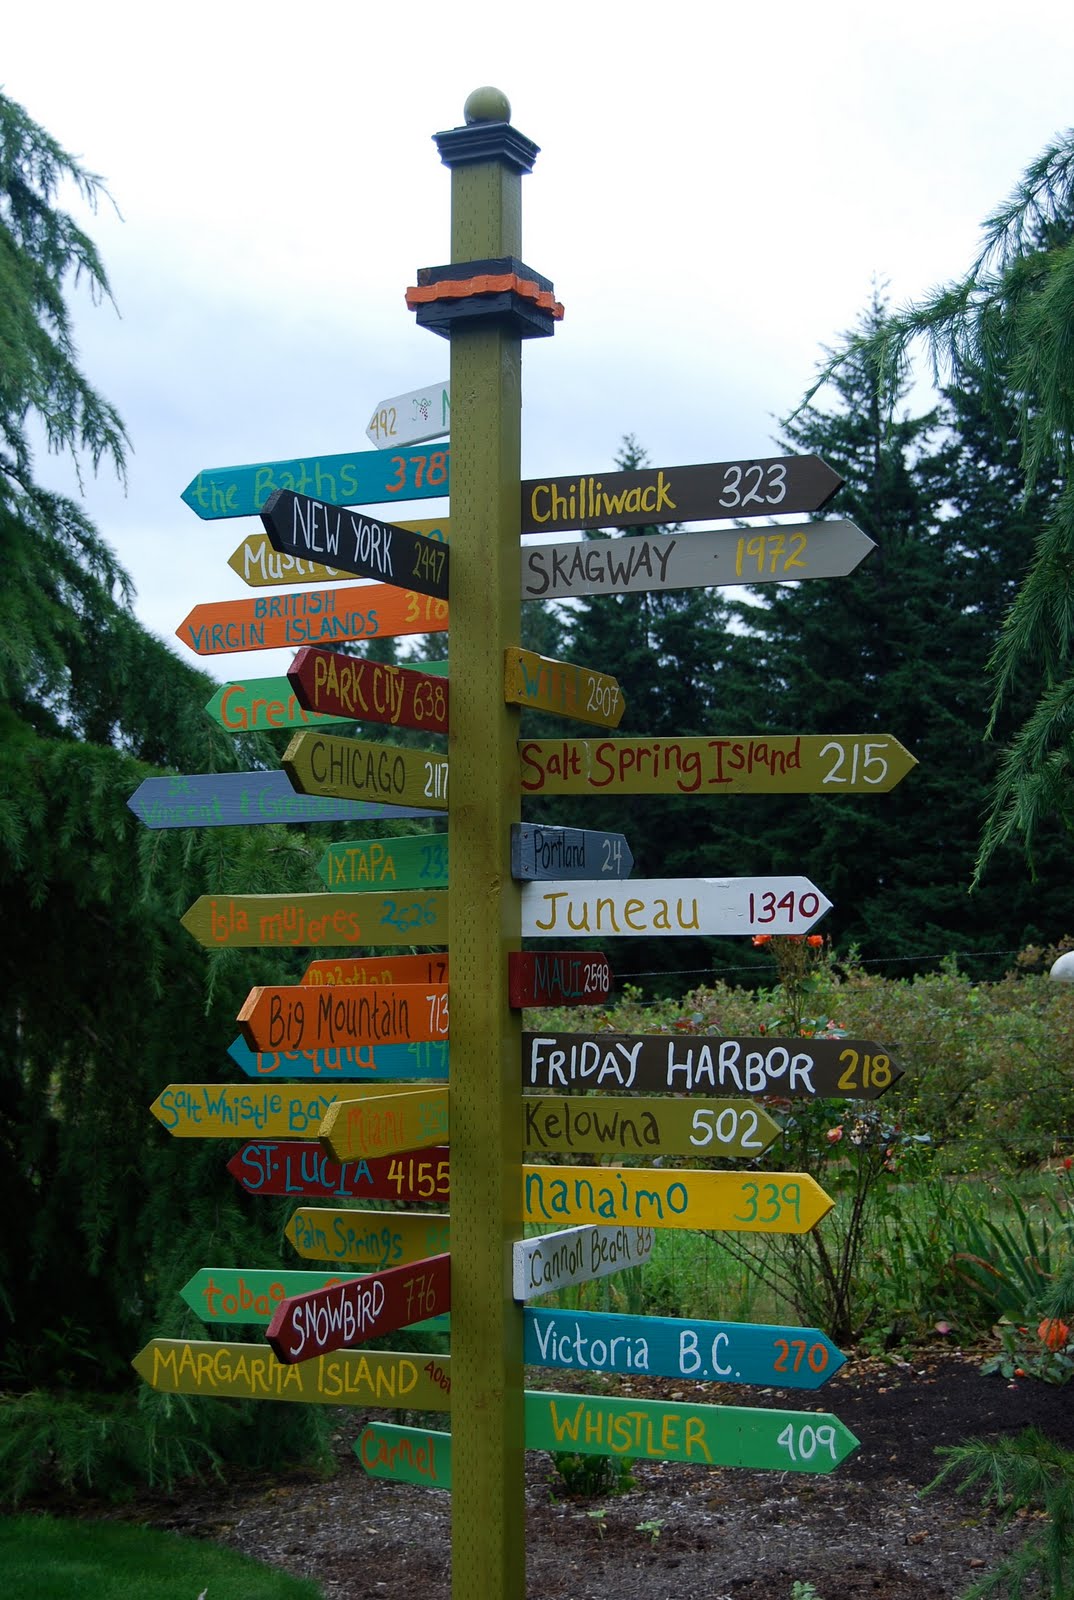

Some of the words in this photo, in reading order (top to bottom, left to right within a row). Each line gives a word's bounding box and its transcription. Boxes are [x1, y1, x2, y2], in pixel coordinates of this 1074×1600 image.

[369, 407, 397, 440] 492
[191, 478, 238, 514] the
[254, 460, 359, 509] Baths
[385, 449, 450, 492] 378
[531, 471, 677, 522] Chilliwack
[718, 463, 788, 508] 323
[291, 496, 341, 556] NEW
[350, 515, 393, 577] YORK
[412, 541, 446, 584] 2447
[526, 540, 677, 594] SKAGWAY
[735, 532, 812, 577] 1972
[188, 621, 266, 651] VIRGIN
[284, 610, 379, 642] ISLANDS
[254, 589, 336, 619] BRITISH
[314, 654, 369, 713] PARK
[413, 681, 446, 722] 638
[586, 676, 620, 717] 2607
[310, 741, 406, 795] CHICAGO
[423, 761, 449, 800] 2117
[520, 742, 582, 791] Salt
[588, 741, 702, 793] Spring
[707, 736, 801, 784] Island
[818, 742, 889, 784] 215
[328, 843, 397, 886] IXTAPA
[533, 829, 586, 875] Portland
[601, 839, 622, 876] 24
[535, 891, 700, 932] Juneau
[748, 891, 820, 924] 1340
[533, 955, 584, 1001] MAUI
[583, 963, 610, 993] 2598
[268, 994, 306, 1050] Big
[317, 990, 411, 1045] Mountain
[425, 993, 449, 1034] 713
[530, 1038, 644, 1088] FRIDAY
[666, 1040, 816, 1094] HARBOR
[837, 1049, 893, 1090] 218
[160, 1090, 202, 1129] Salt
[524, 1101, 661, 1148] Kelowna
[688, 1107, 763, 1148] 502
[525, 1171, 690, 1220] nanaimo
[732, 1182, 801, 1225] 339
[294, 1215, 330, 1255] Palm
[333, 1216, 404, 1264] Springs
[531, 1236, 583, 1287] Cannon
[591, 1226, 631, 1273] Beach
[402, 1273, 437, 1321] 776
[153, 1343, 304, 1395] MARGARITA
[317, 1354, 419, 1399] ISLAND
[533, 1317, 649, 1370] Victoria
[678, 1329, 742, 1378] B.C.
[773, 1338, 830, 1374] 270
[361, 1428, 438, 1481] Carmel
[550, 1399, 713, 1463] WHISTLER
[777, 1423, 838, 1461] 409
